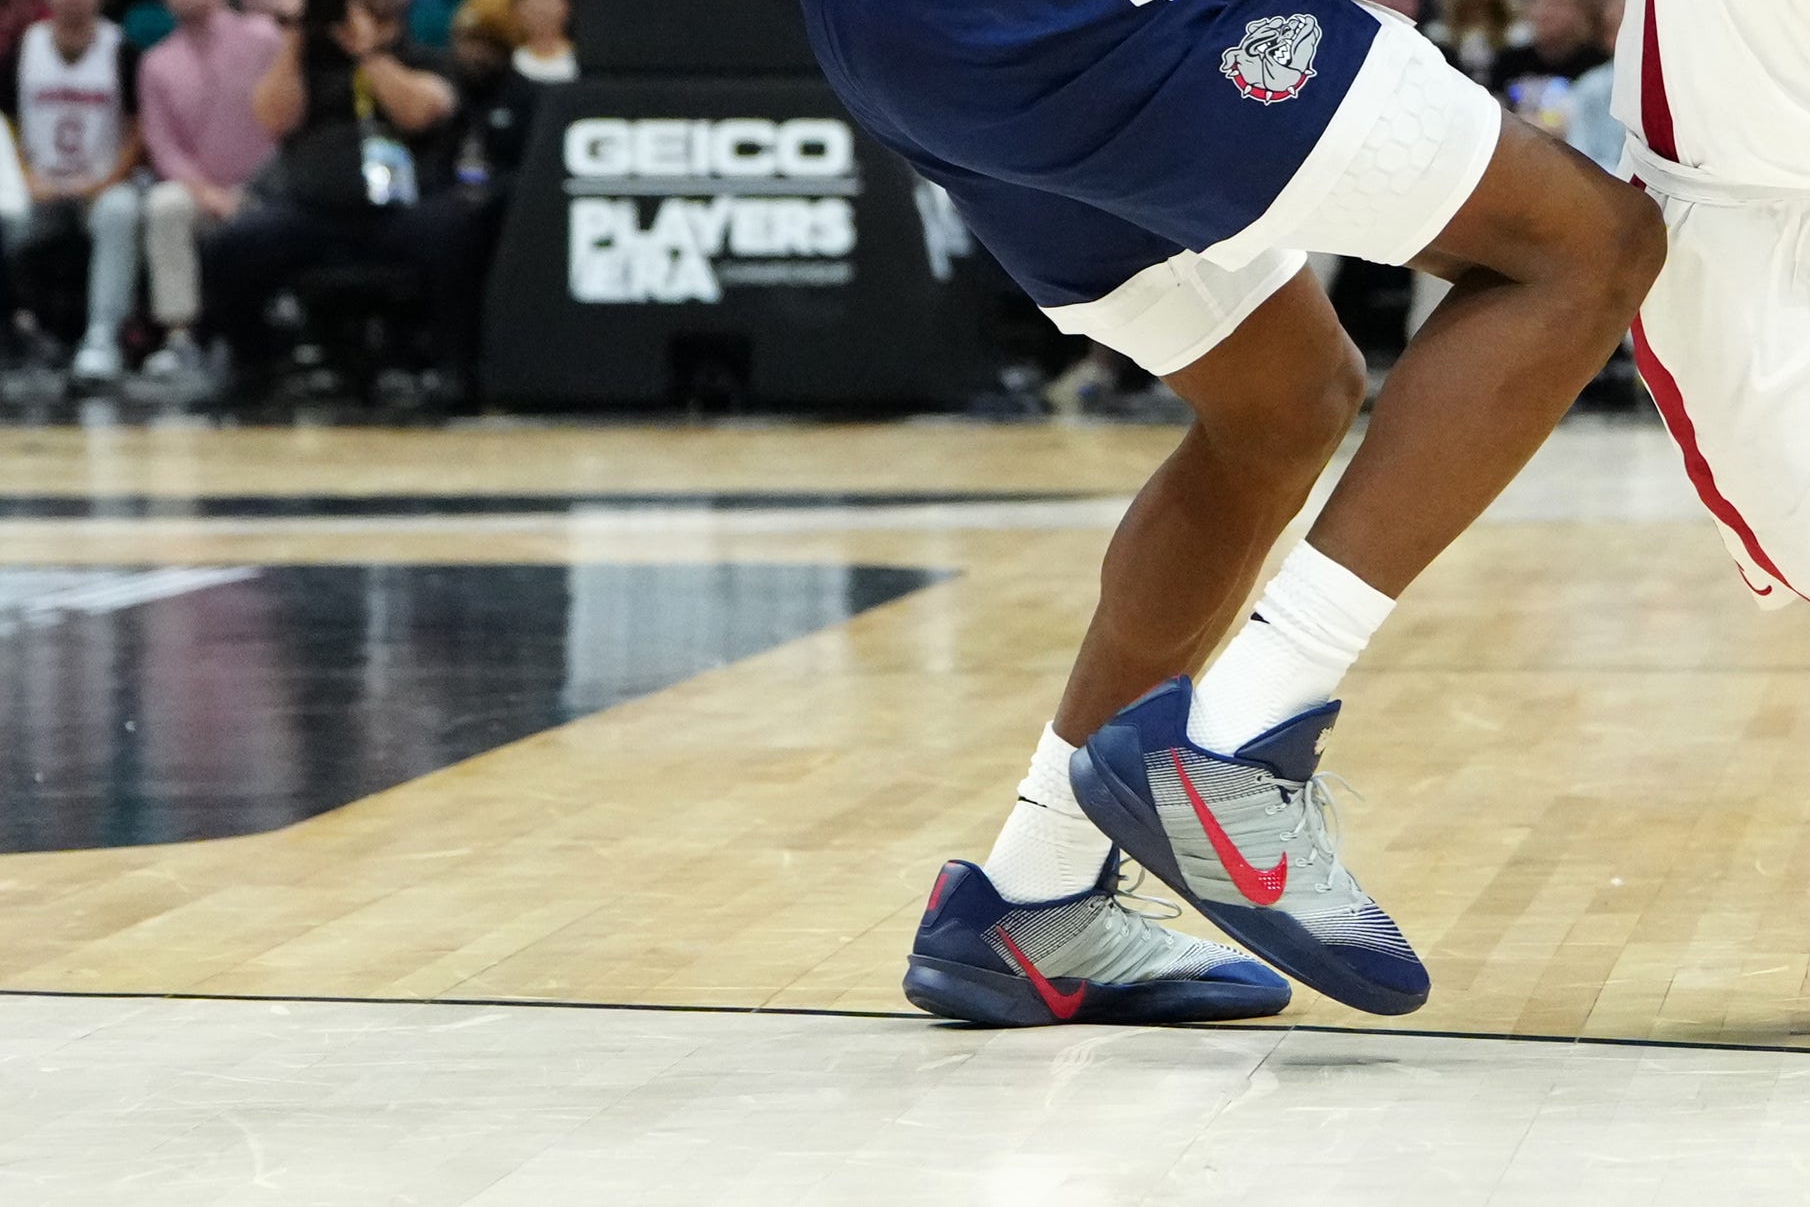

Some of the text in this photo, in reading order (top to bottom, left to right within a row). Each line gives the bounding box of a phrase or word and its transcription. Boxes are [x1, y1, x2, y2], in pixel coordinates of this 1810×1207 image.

[563, 117, 854, 177] GEICO
[569, 196, 857, 257] PLAYERS
[569, 250, 721, 304] ERA
